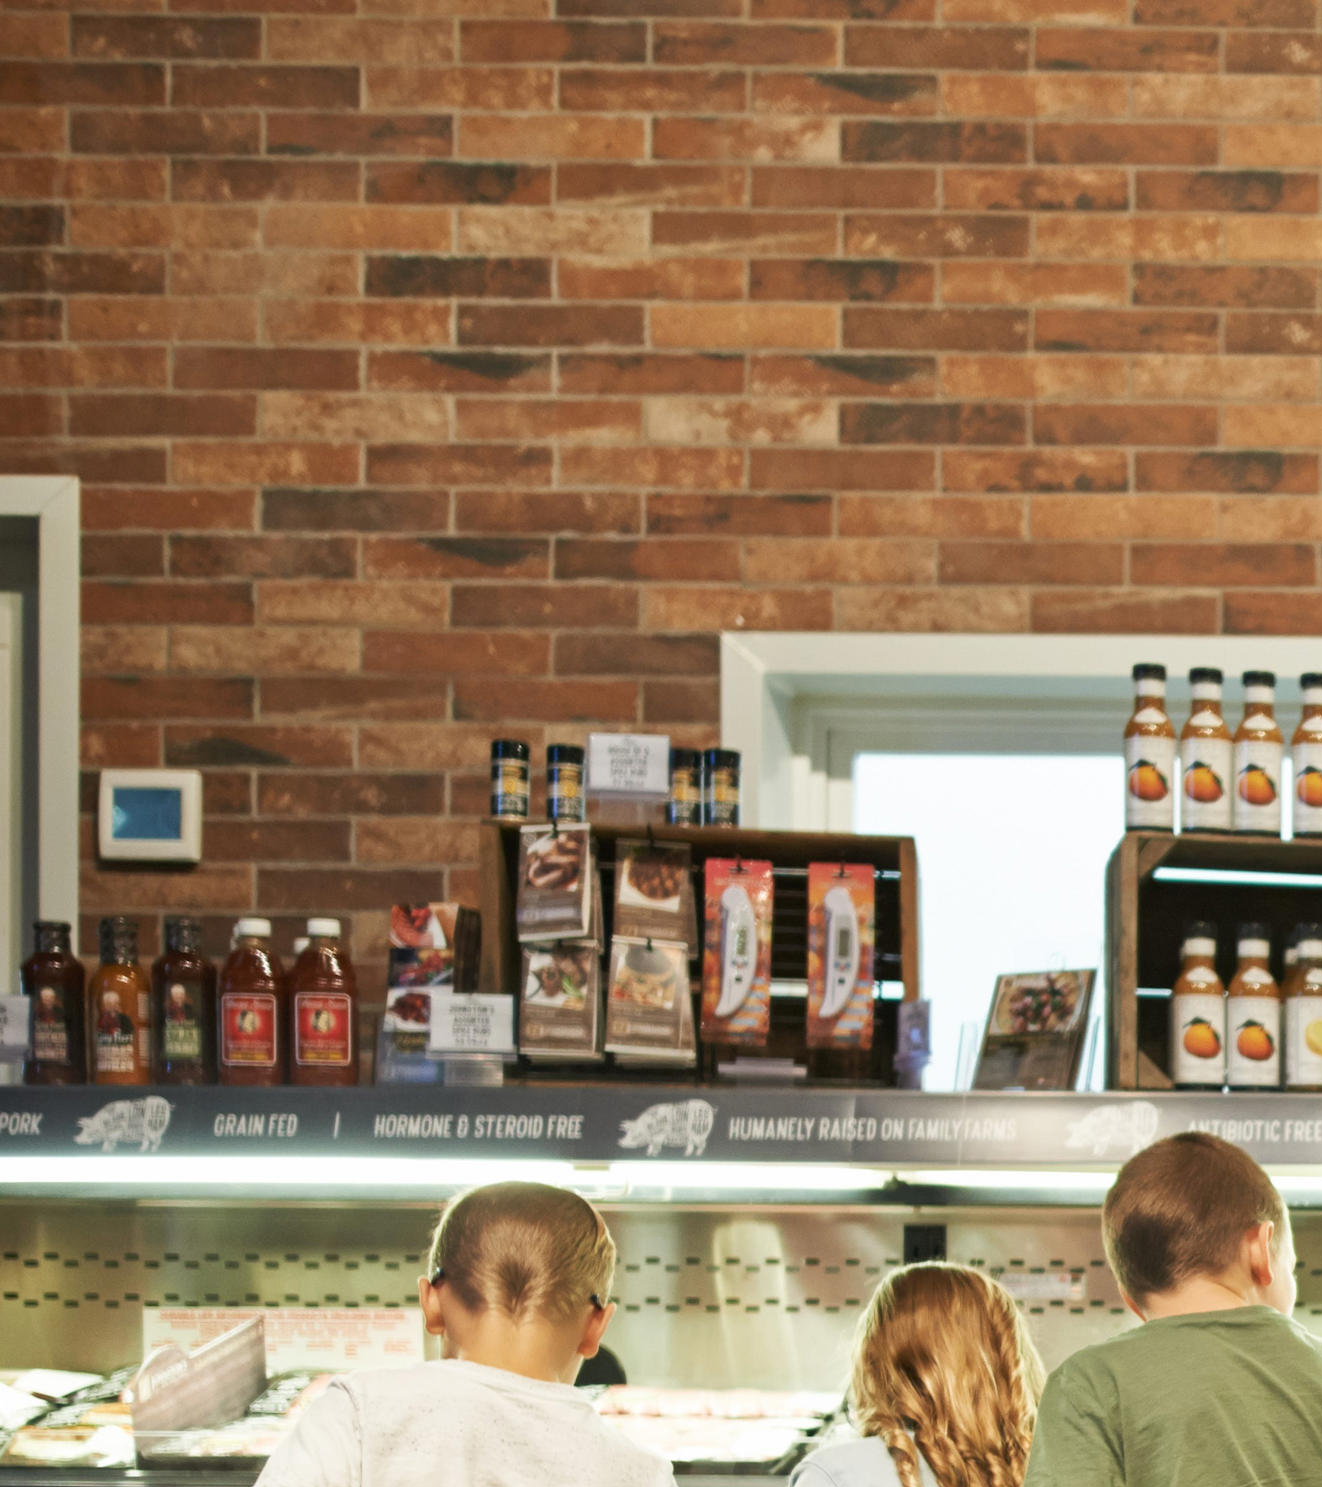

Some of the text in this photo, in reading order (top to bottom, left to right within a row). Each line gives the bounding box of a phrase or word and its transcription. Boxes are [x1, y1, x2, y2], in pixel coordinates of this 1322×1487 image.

[0, 1112, 42, 1135] PORK
[213, 1113, 298, 1137] GRAIN FED
[374, 1114, 585, 1139] HORMONE & STEROID FREE
[729, 1118, 1017, 1142] HUMANELY RAISED ON FAMILY FARMS
[1284, 1120, 1322, 1141] FREE
